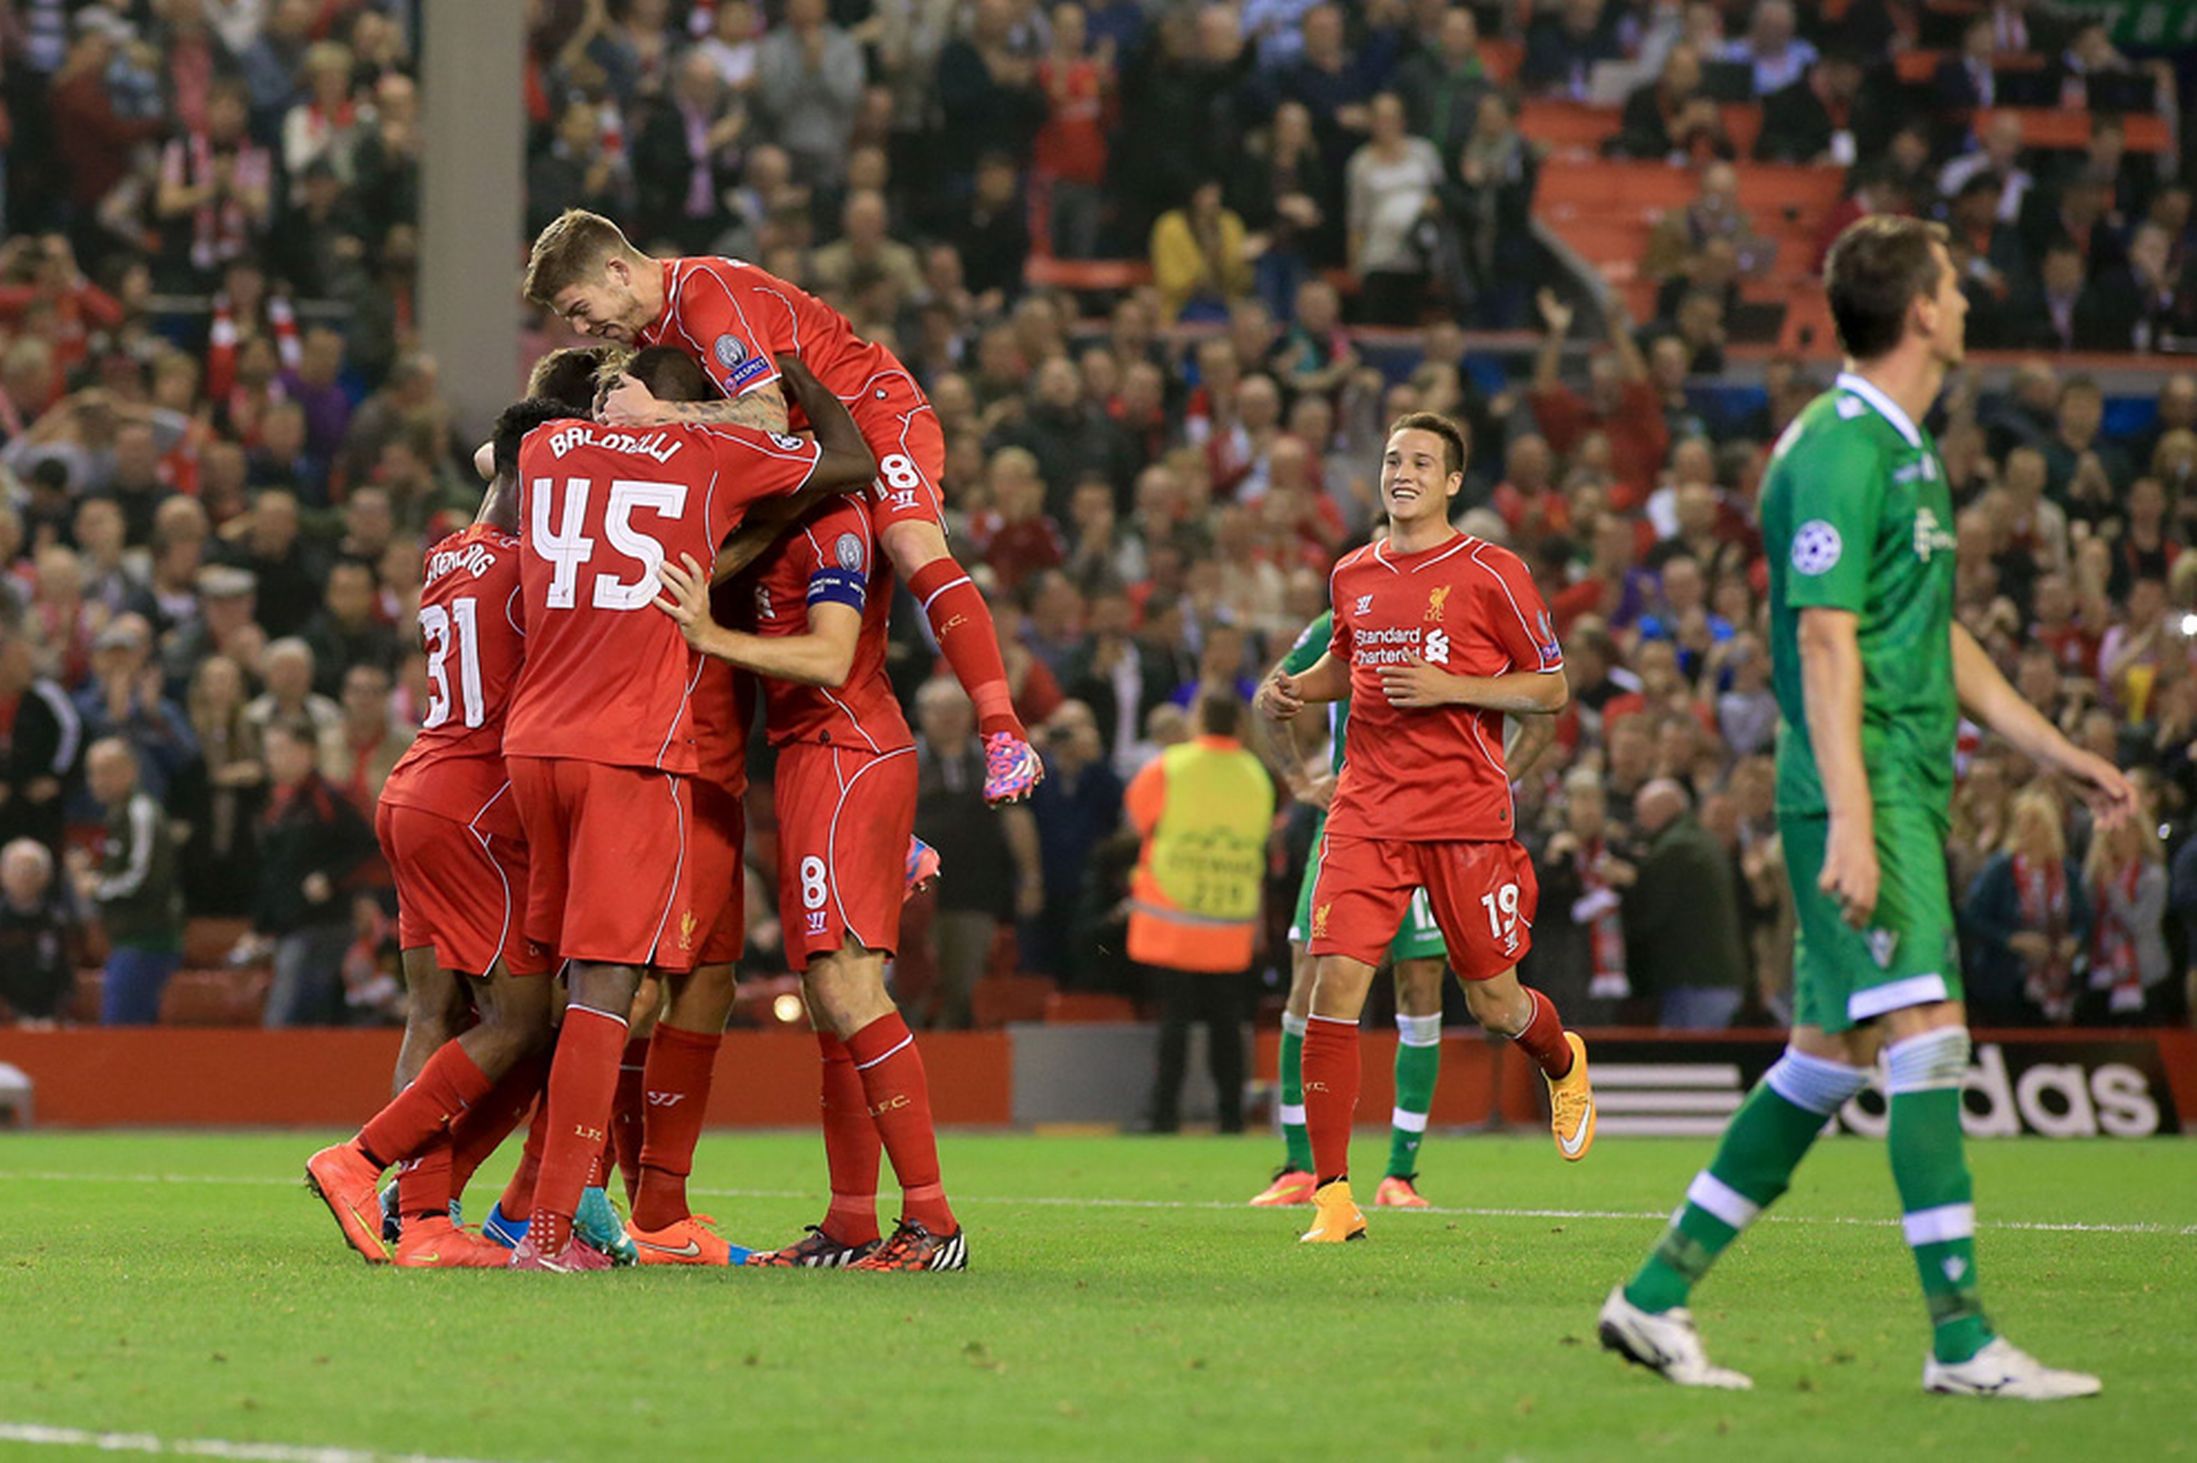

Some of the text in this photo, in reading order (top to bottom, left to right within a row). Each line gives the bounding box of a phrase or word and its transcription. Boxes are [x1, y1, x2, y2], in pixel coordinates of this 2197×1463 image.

[531, 477, 688, 610] 45
[417, 598, 485, 729] 31
[1355, 627, 1421, 646] Standard
[800, 855, 828, 910] 8
[1481, 883, 1520, 940] 19
